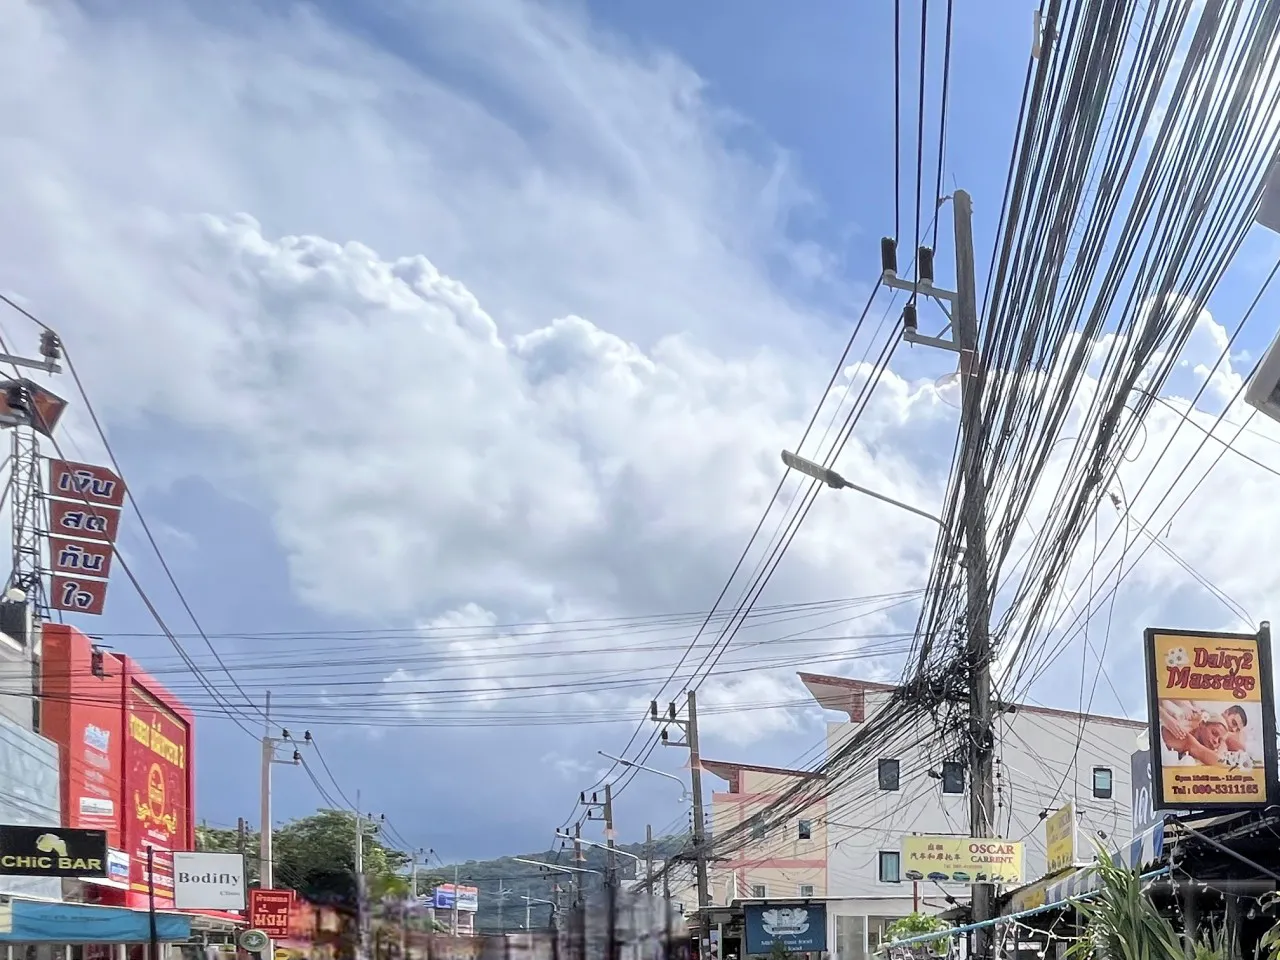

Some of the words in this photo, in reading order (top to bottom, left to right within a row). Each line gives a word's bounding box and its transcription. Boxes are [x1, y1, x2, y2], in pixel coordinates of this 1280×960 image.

[1166, 666, 1256, 699] Massage
[968, 844, 1014, 855] OSCAR
[58, 857, 102, 870] BAR
[179, 872, 240, 886] Bodifly
